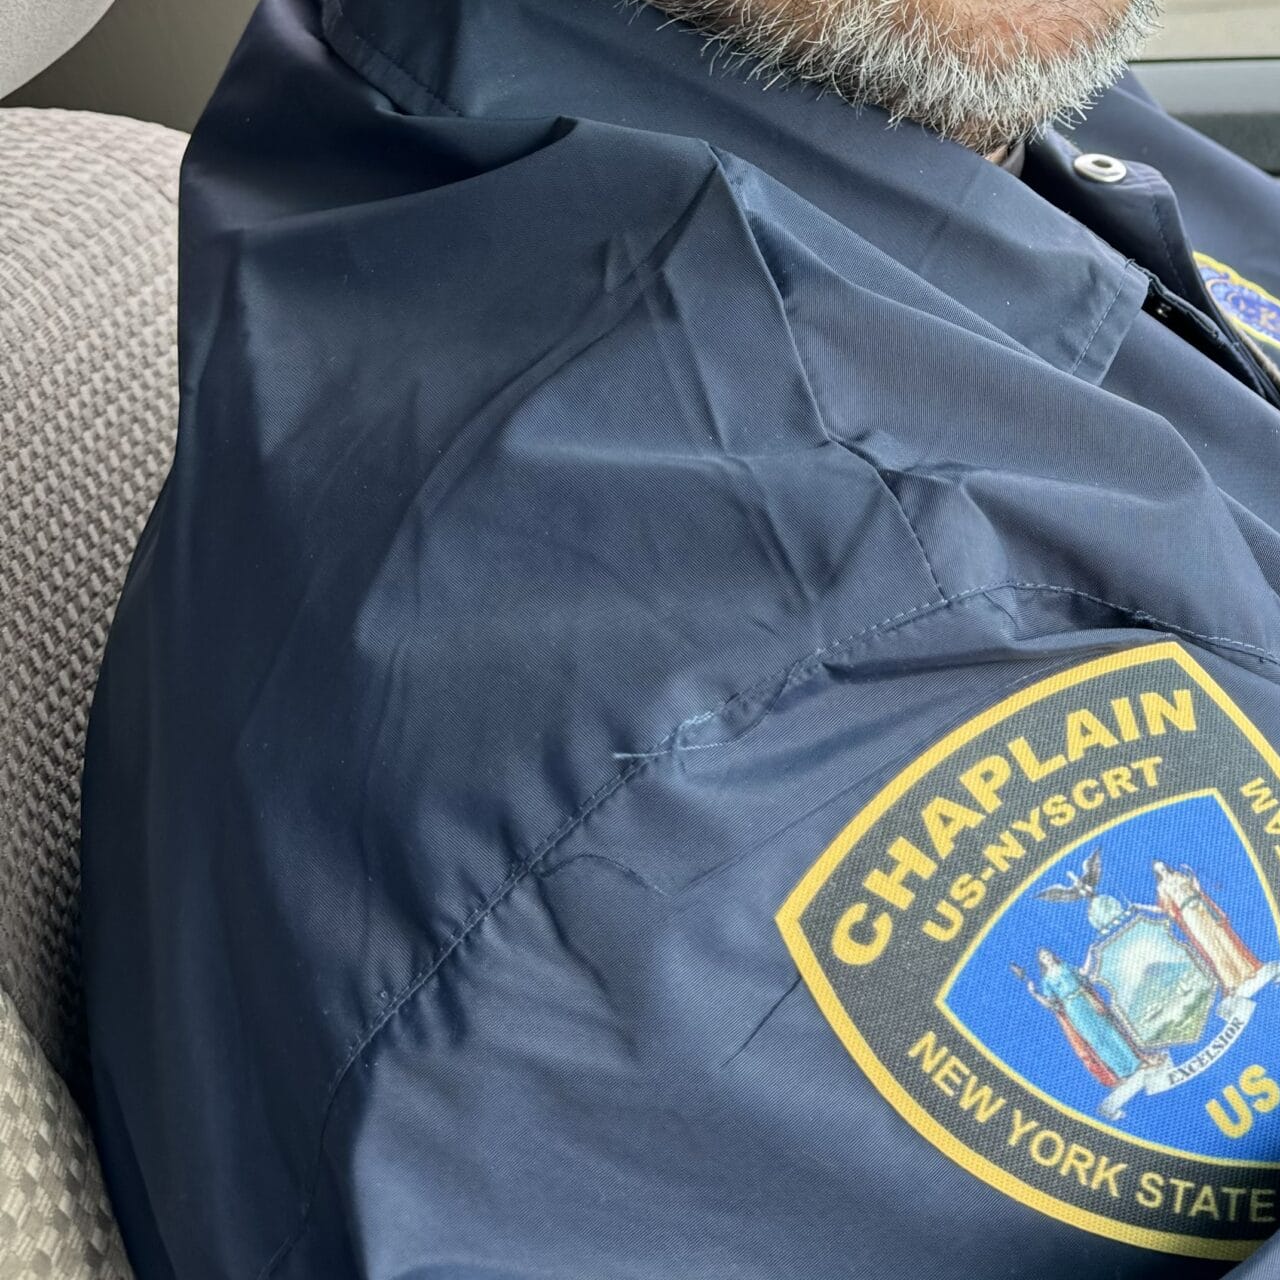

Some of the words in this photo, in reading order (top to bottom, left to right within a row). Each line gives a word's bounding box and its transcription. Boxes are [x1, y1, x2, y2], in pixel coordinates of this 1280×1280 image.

[831, 689, 1198, 966] CHAPLAIN
[922, 756, 1163, 942] US-NYSCRT
[907, 1030, 1006, 1124] NEW
[1005, 1106, 1128, 1198] YORK
[1135, 1172, 1277, 1223] STATE
[1168, 1016, 1244, 1086] EXCELSIOR
